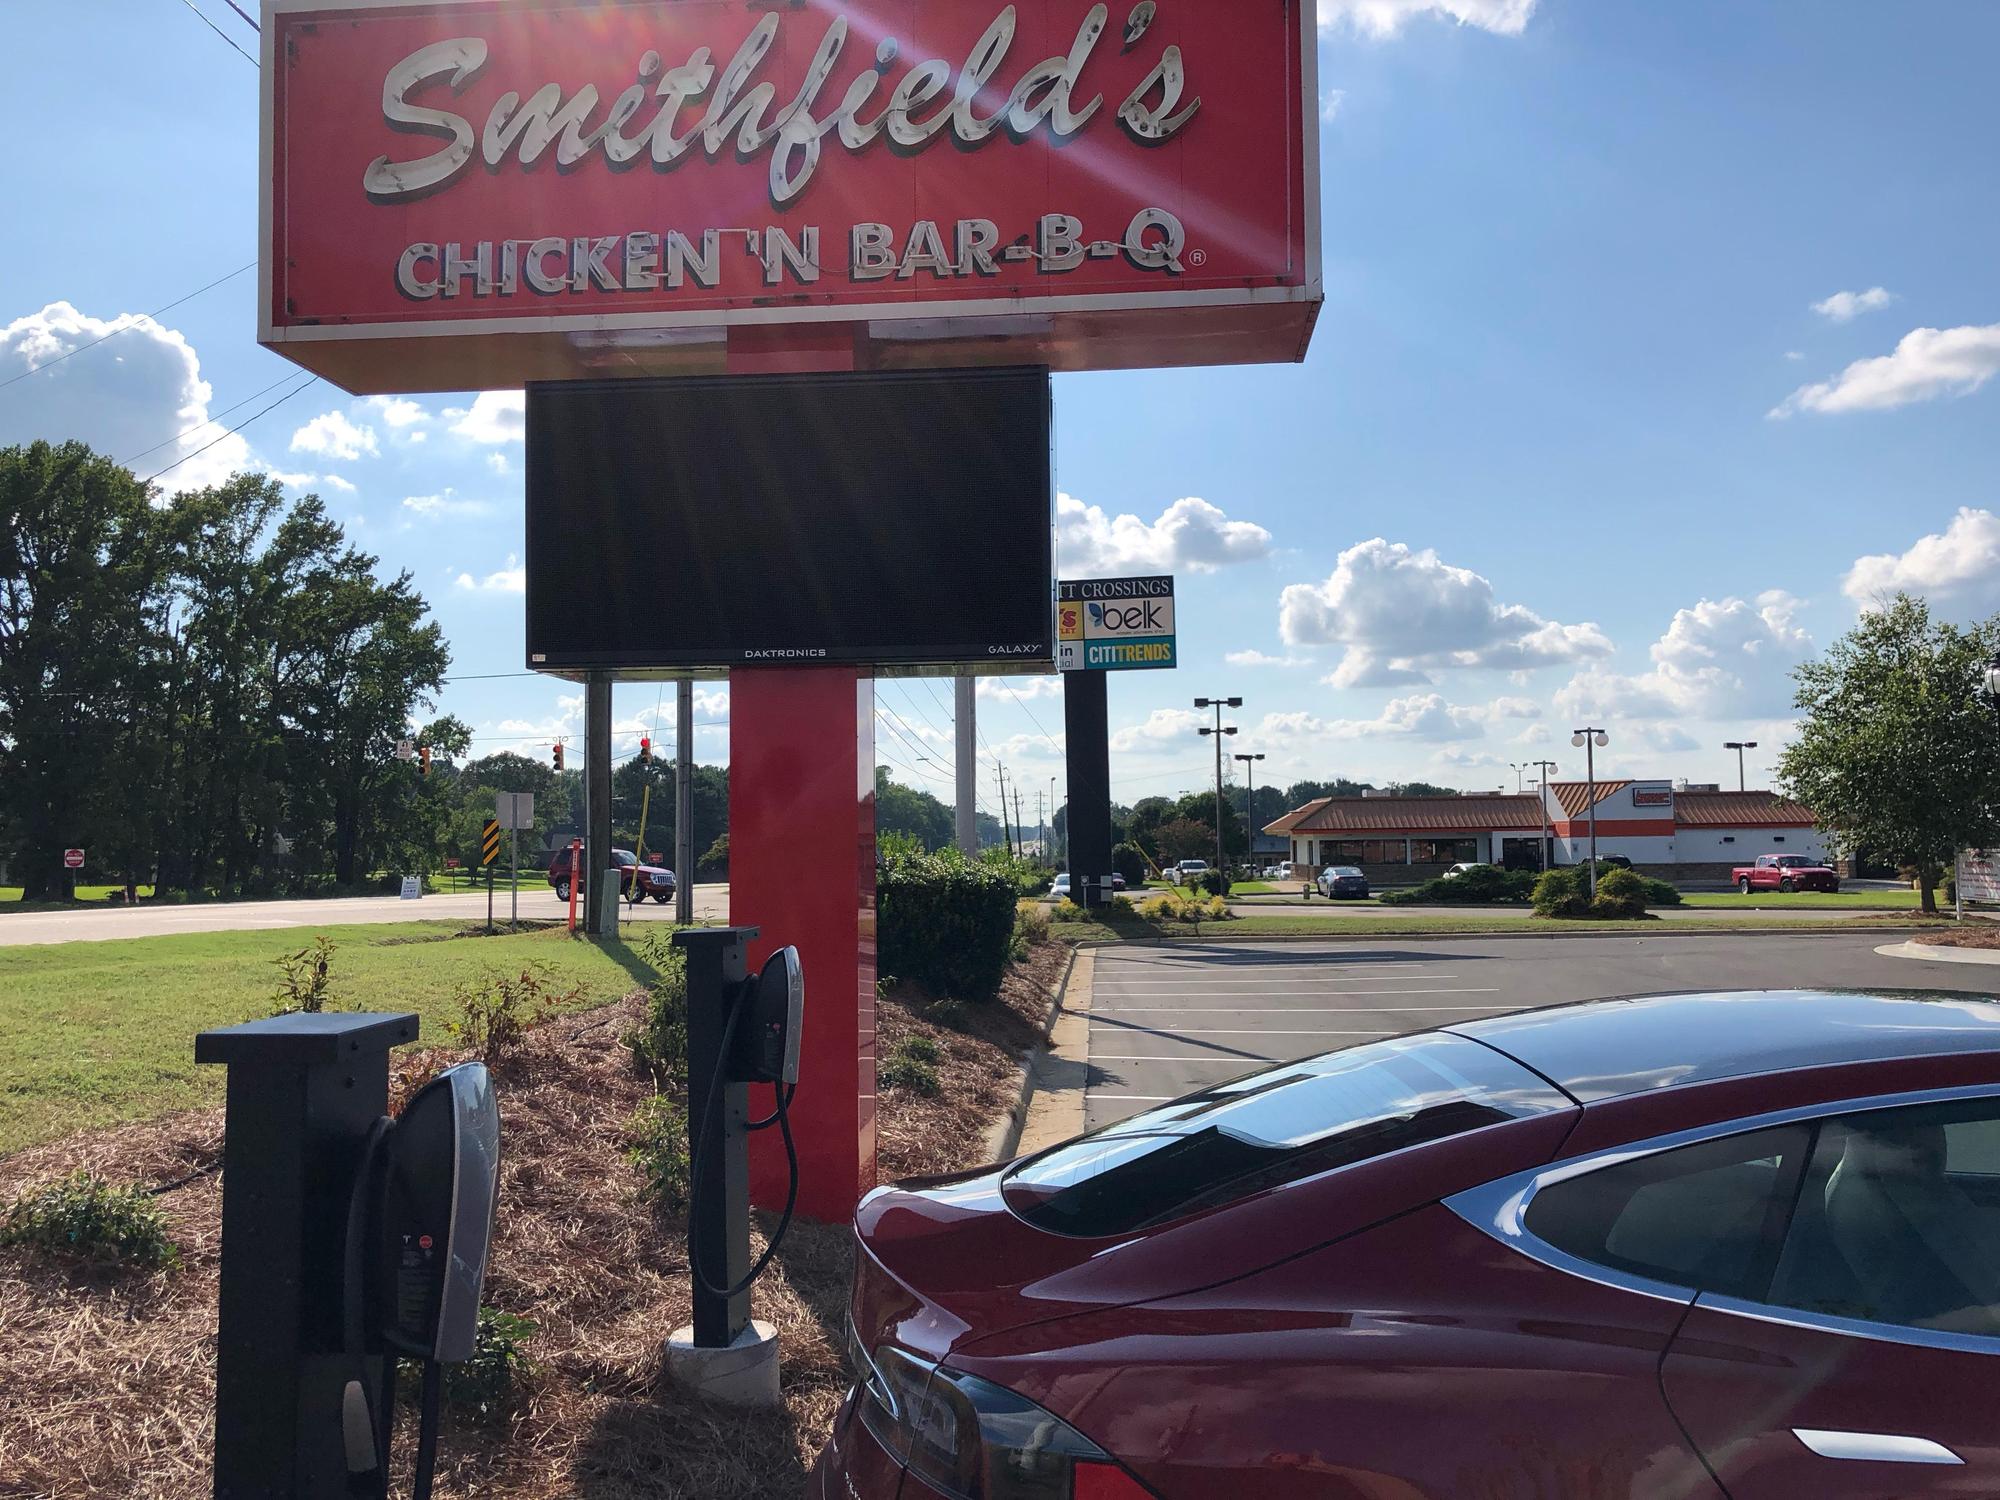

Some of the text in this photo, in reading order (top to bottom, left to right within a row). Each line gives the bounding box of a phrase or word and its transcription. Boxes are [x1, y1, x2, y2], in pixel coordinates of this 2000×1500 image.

[363, 0, 1202, 202] Smithfield's
[397, 207, 1187, 299] CHICKEN 'N BAR-B-Q
[1081, 579, 1169, 598] CROSSINGS
[1102, 600, 1164, 631] belk
[744, 649, 827, 658] DAKTRONICS
[988, 644, 1040, 654] GALAXY
